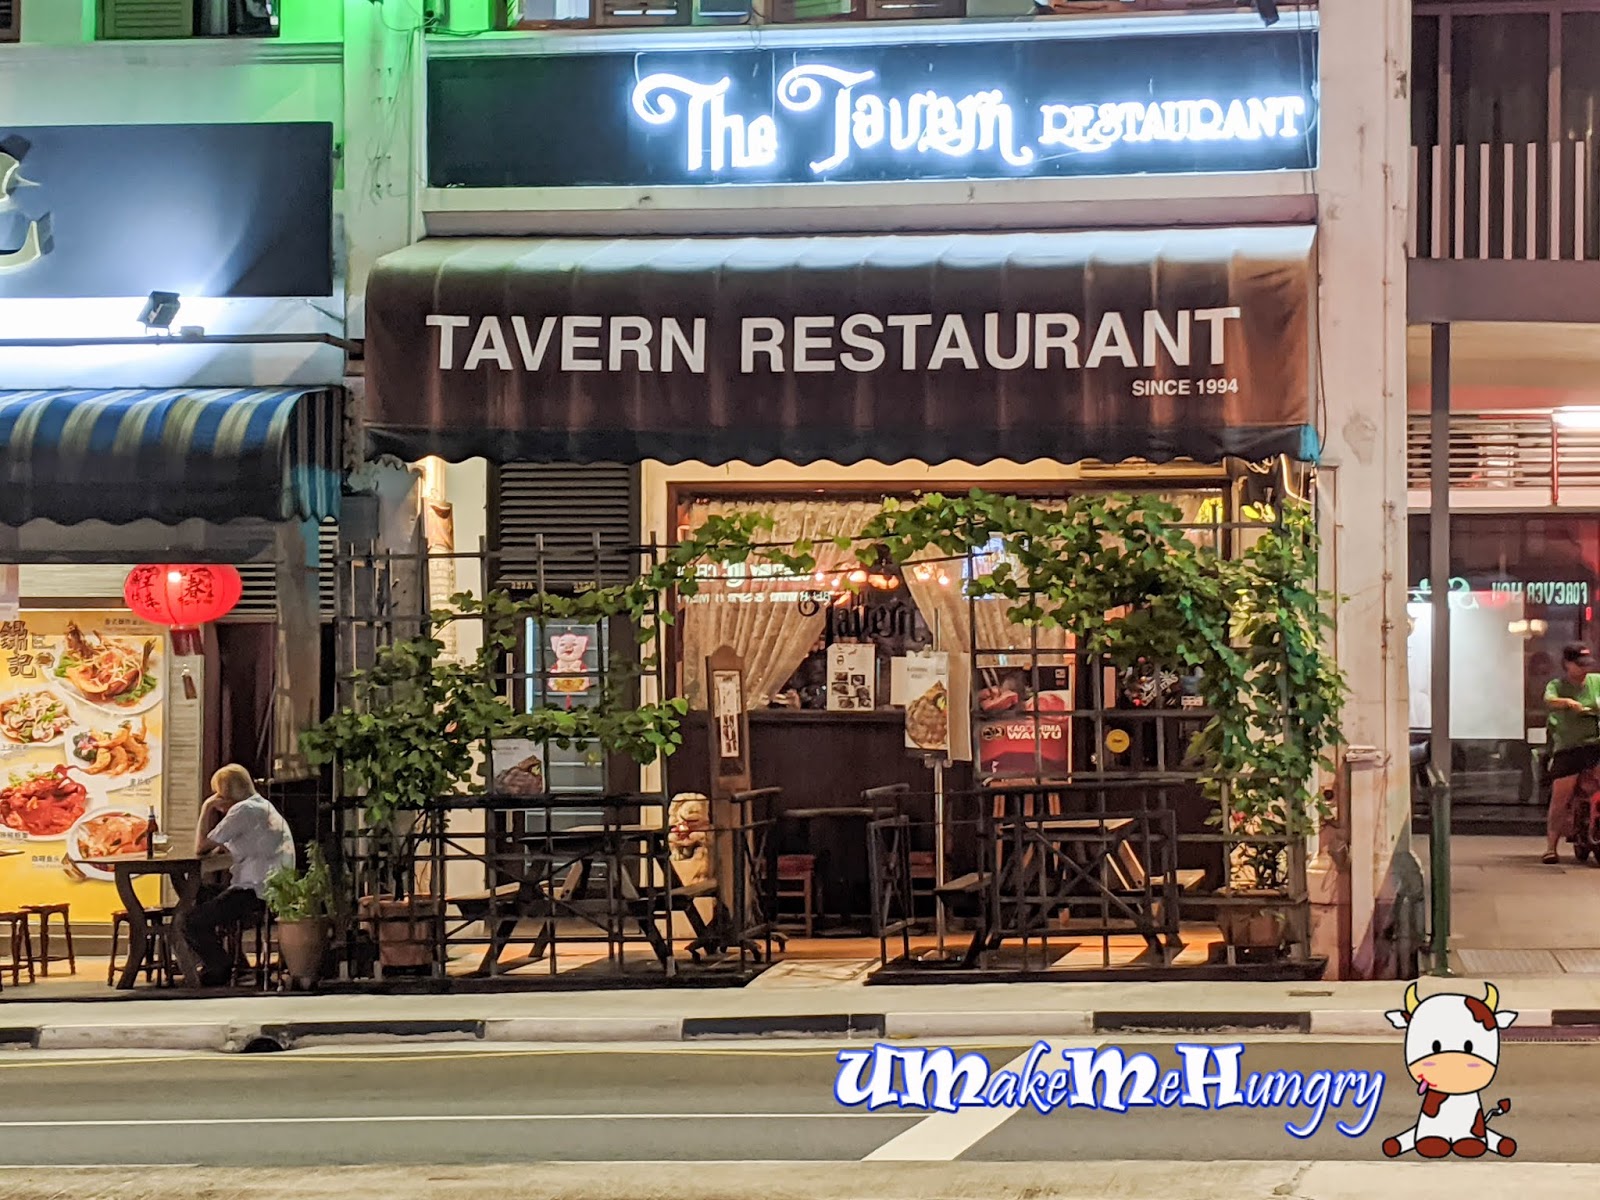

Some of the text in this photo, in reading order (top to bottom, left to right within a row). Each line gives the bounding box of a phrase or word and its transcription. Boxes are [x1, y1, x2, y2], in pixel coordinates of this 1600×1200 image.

[632, 63, 1304, 174] The Tavern RESTAURANT
[425, 306, 1242, 374] TAVERN RESTAURANT
[1131, 377, 1239, 396] SINCE 1994
[1006, 724, 1062, 732] KAGOHIMA
